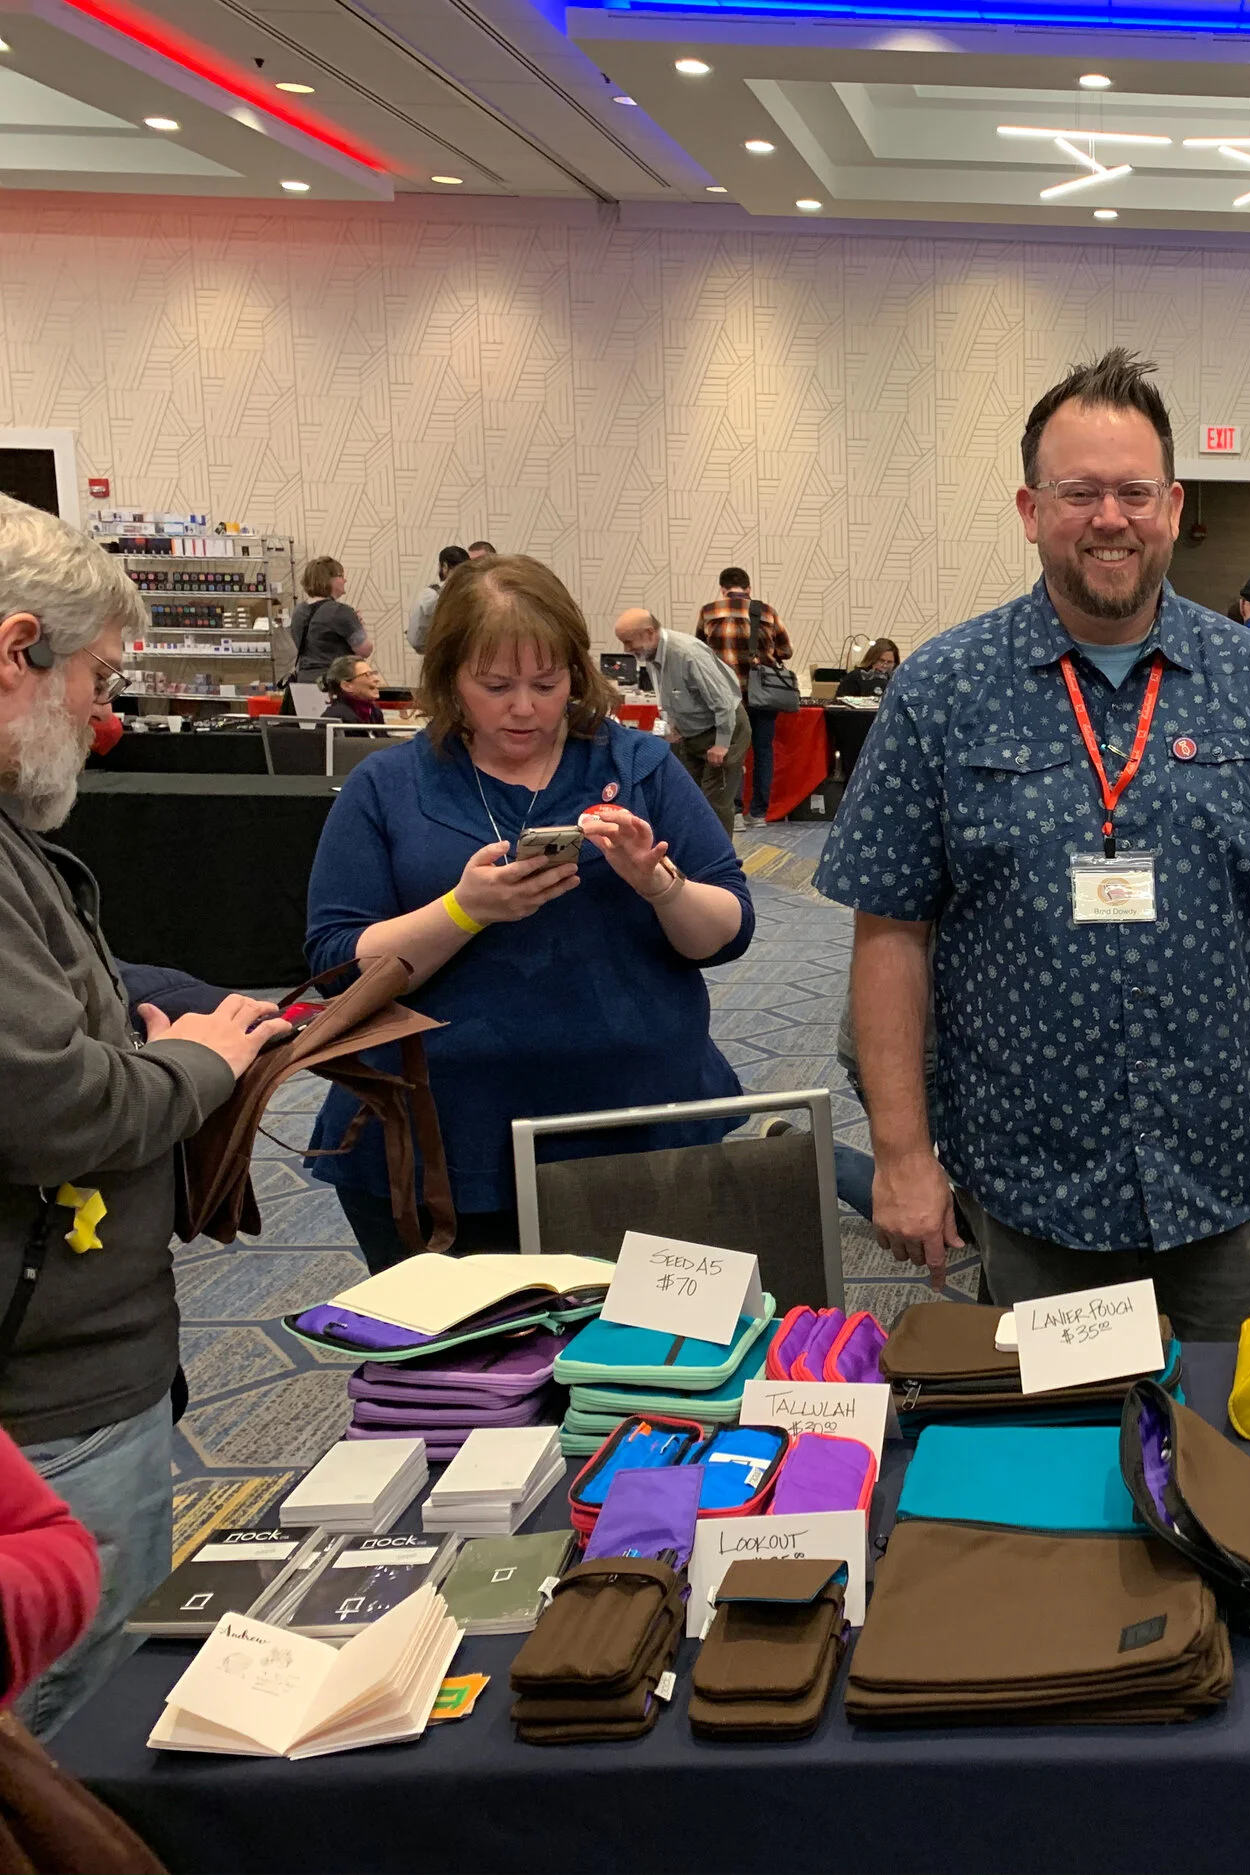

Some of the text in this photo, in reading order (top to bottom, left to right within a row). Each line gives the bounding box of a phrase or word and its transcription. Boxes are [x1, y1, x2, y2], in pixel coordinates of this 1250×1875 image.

[1207, 427, 1235, 450] EXIT
[656, 1273, 698, 1296] $70
[1031, 1296, 1134, 1331] LANIER POUCH
[765, 1390, 856, 1418] TALLULAH
[718, 1529, 810, 1556] LOOKOUT
